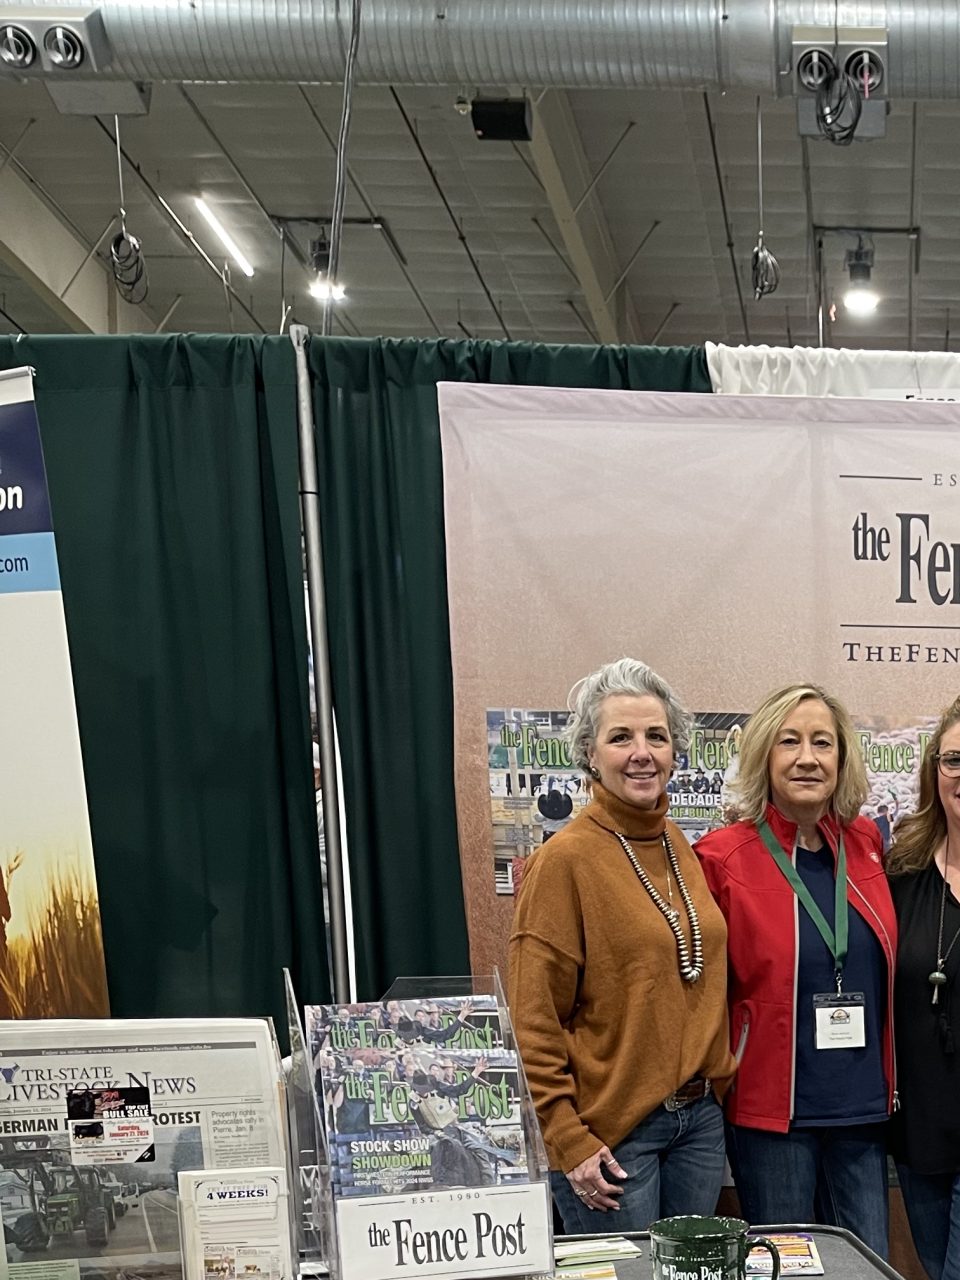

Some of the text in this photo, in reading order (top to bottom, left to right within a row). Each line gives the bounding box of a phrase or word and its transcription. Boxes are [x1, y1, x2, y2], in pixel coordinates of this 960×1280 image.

[852, 512, 890, 562] the
[501, 724, 572, 767] the Fenc
[671, 793, 722, 806] DECADE
[672, 807, 723, 819] OF BULLS
[21, 1066, 114, 1083] TRI-STATE
[344, 1071, 371, 1099] the
[102, 1109, 150, 1119] BULL SALE
[0, 1118, 58, 1135] ERMAN
[350, 1139, 430, 1153] STOCK SHOW
[352, 1154, 432, 1170] SHOWDOWN
[206, 1189, 269, 1200] 4 WEEKS!
[449, 1192, 481, 1202] 1980
[368, 1211, 527, 1267] the Fence Post
